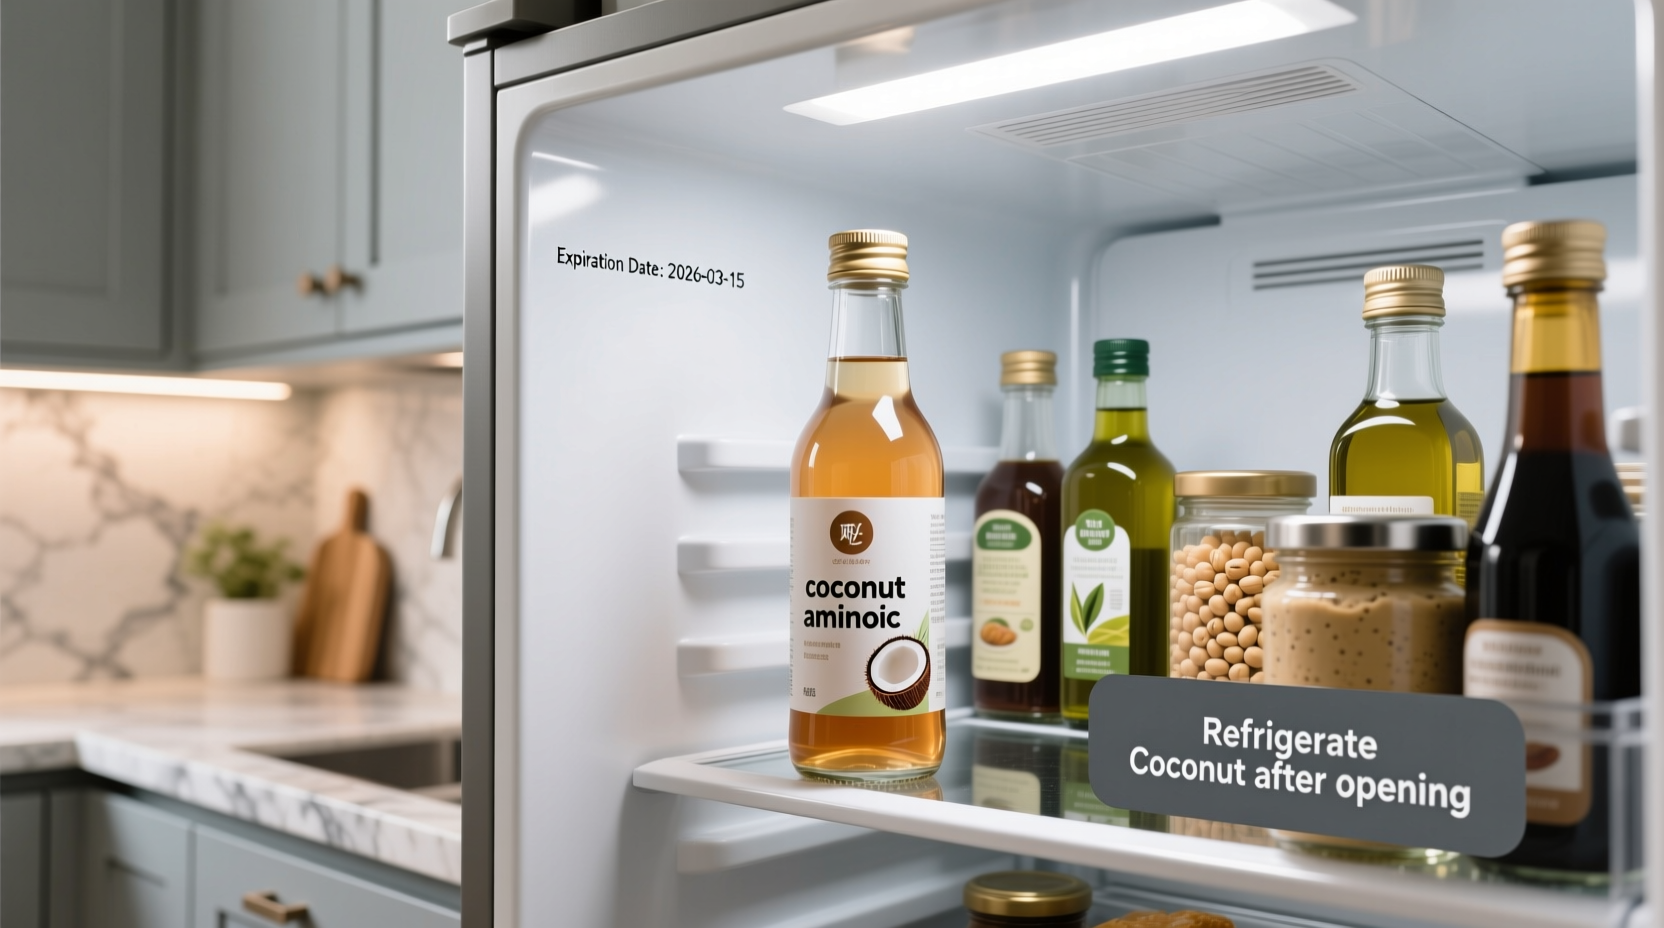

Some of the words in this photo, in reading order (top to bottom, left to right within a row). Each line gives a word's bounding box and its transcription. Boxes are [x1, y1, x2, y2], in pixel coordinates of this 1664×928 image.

[557, 246, 624, 272] Expiration
[628, 257, 664, 278] Date:
[667, 262, 745, 289] 2026-03-15
[805, 576, 906, 599] coconut
[803, 604, 901, 629] aminoic
[1203, 716, 1378, 760] Refrigerate
[1129, 746, 1246, 787] Coconut
[1254, 760, 1327, 795] after
[1335, 773, 1472, 820] opening
